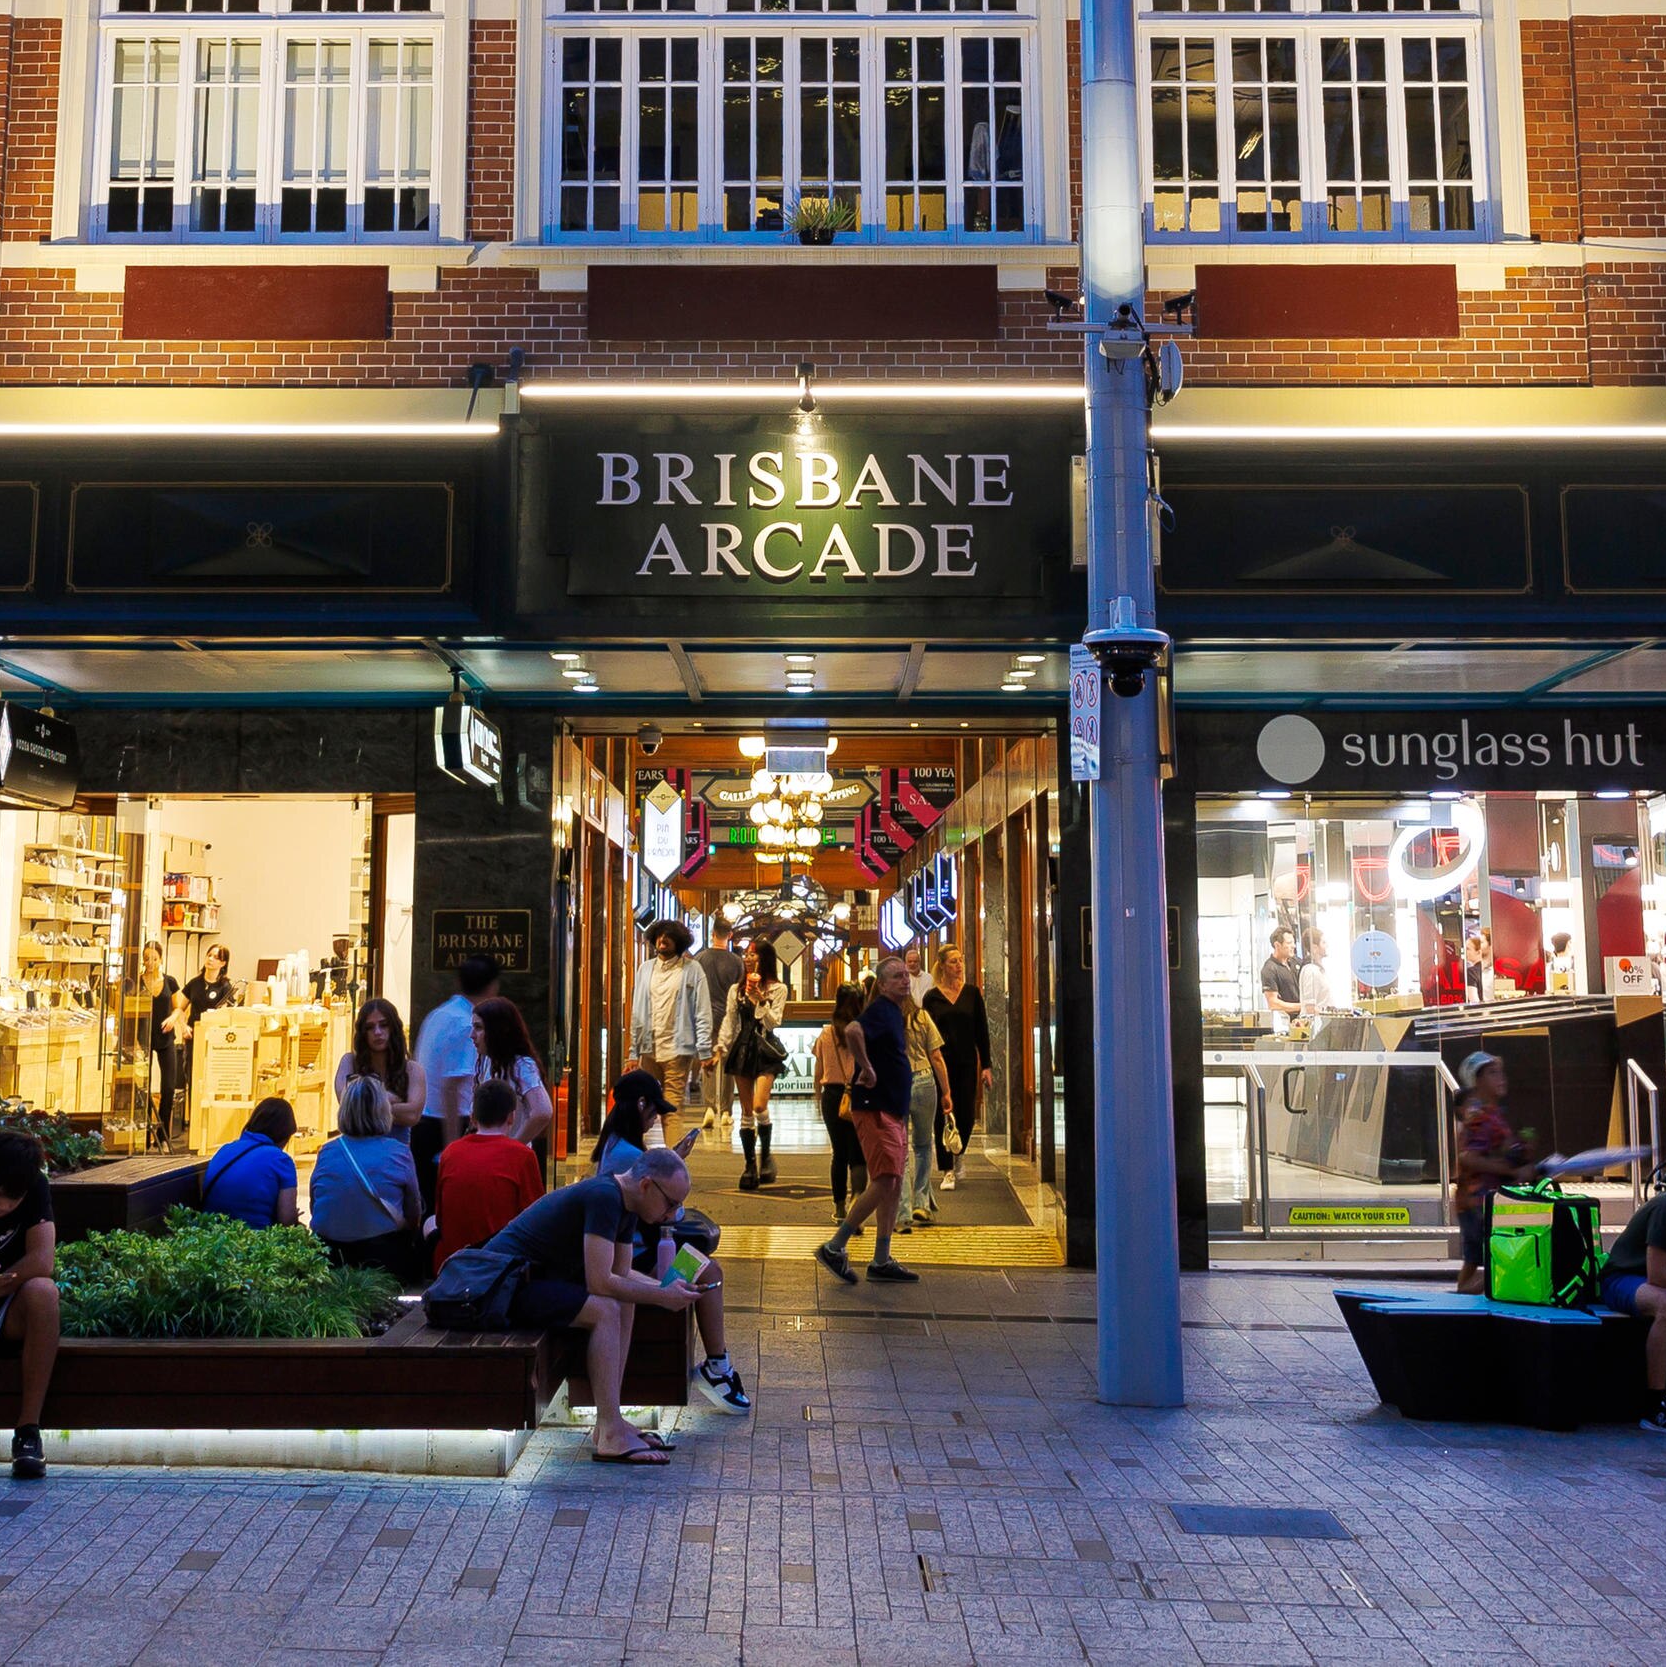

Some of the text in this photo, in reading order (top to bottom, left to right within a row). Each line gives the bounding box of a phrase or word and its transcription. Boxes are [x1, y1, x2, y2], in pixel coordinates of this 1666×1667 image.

[596, 451, 1014, 508] BRISBANE
[635, 521, 978, 579] ARCADE
[1342, 718, 1645, 780] sunglass hut
[914, 768, 932, 778] 100
[464, 915, 499, 930] THE
[438, 934, 524, 949] BRISBANE
[1623, 975, 1645, 984] OFF
[1293, 1212, 1406, 1221] CAUTION: WATCH YOUR STEP
